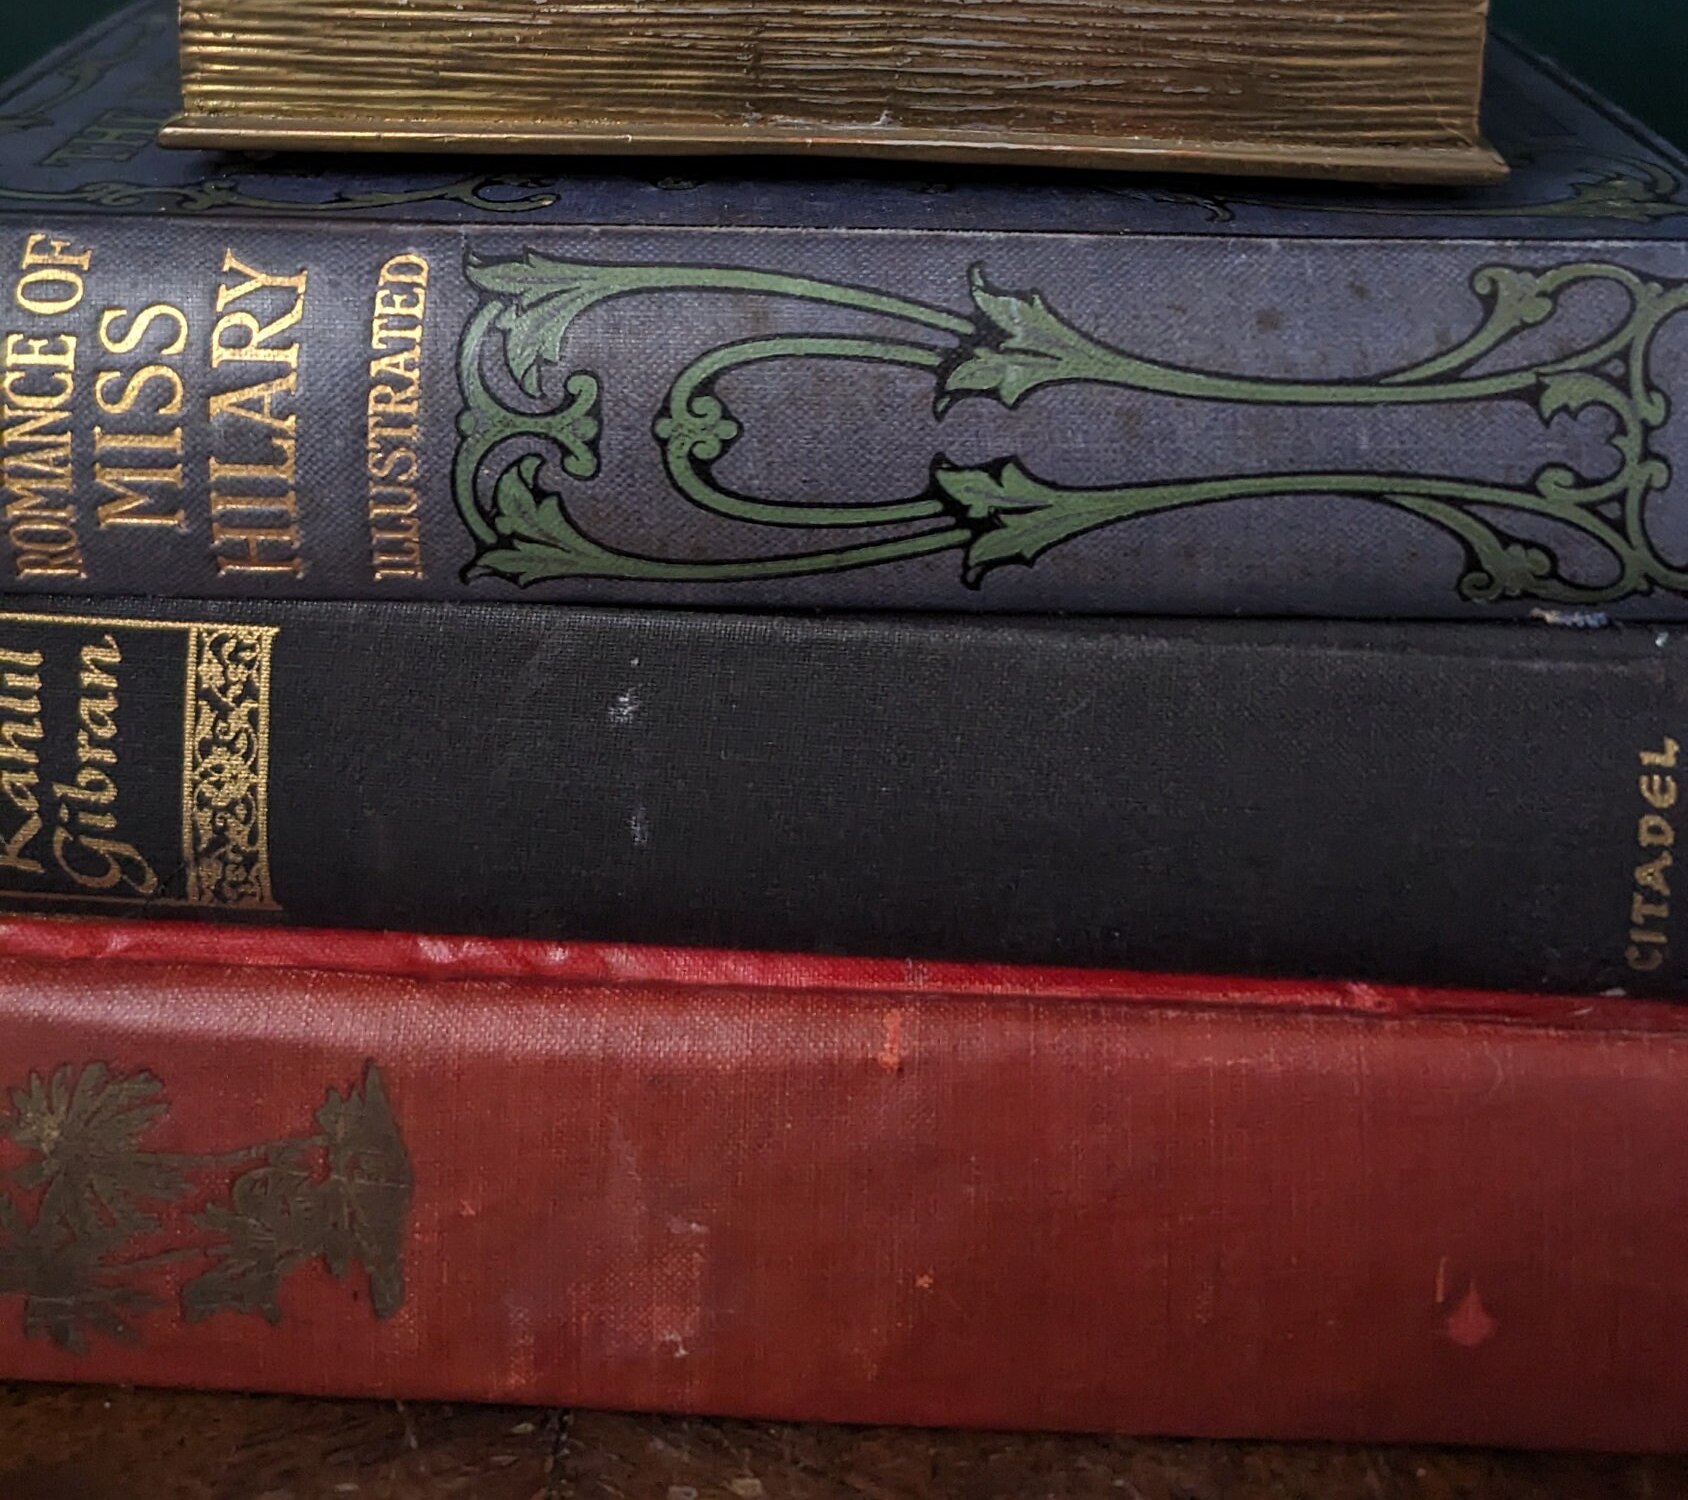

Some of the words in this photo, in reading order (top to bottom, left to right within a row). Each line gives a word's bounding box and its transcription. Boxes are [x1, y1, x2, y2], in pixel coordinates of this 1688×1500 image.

[15, 232, 93, 315] OF
[2, 332, 87, 580] ROMANCE
[94, 304, 189, 532] MISS
[207, 248, 308, 579] HILARY
[366, 252, 430, 581] ILLUSTRATED
[52, 633, 158, 894] Gibran
[1625, 736, 1681, 972] CITADEL
